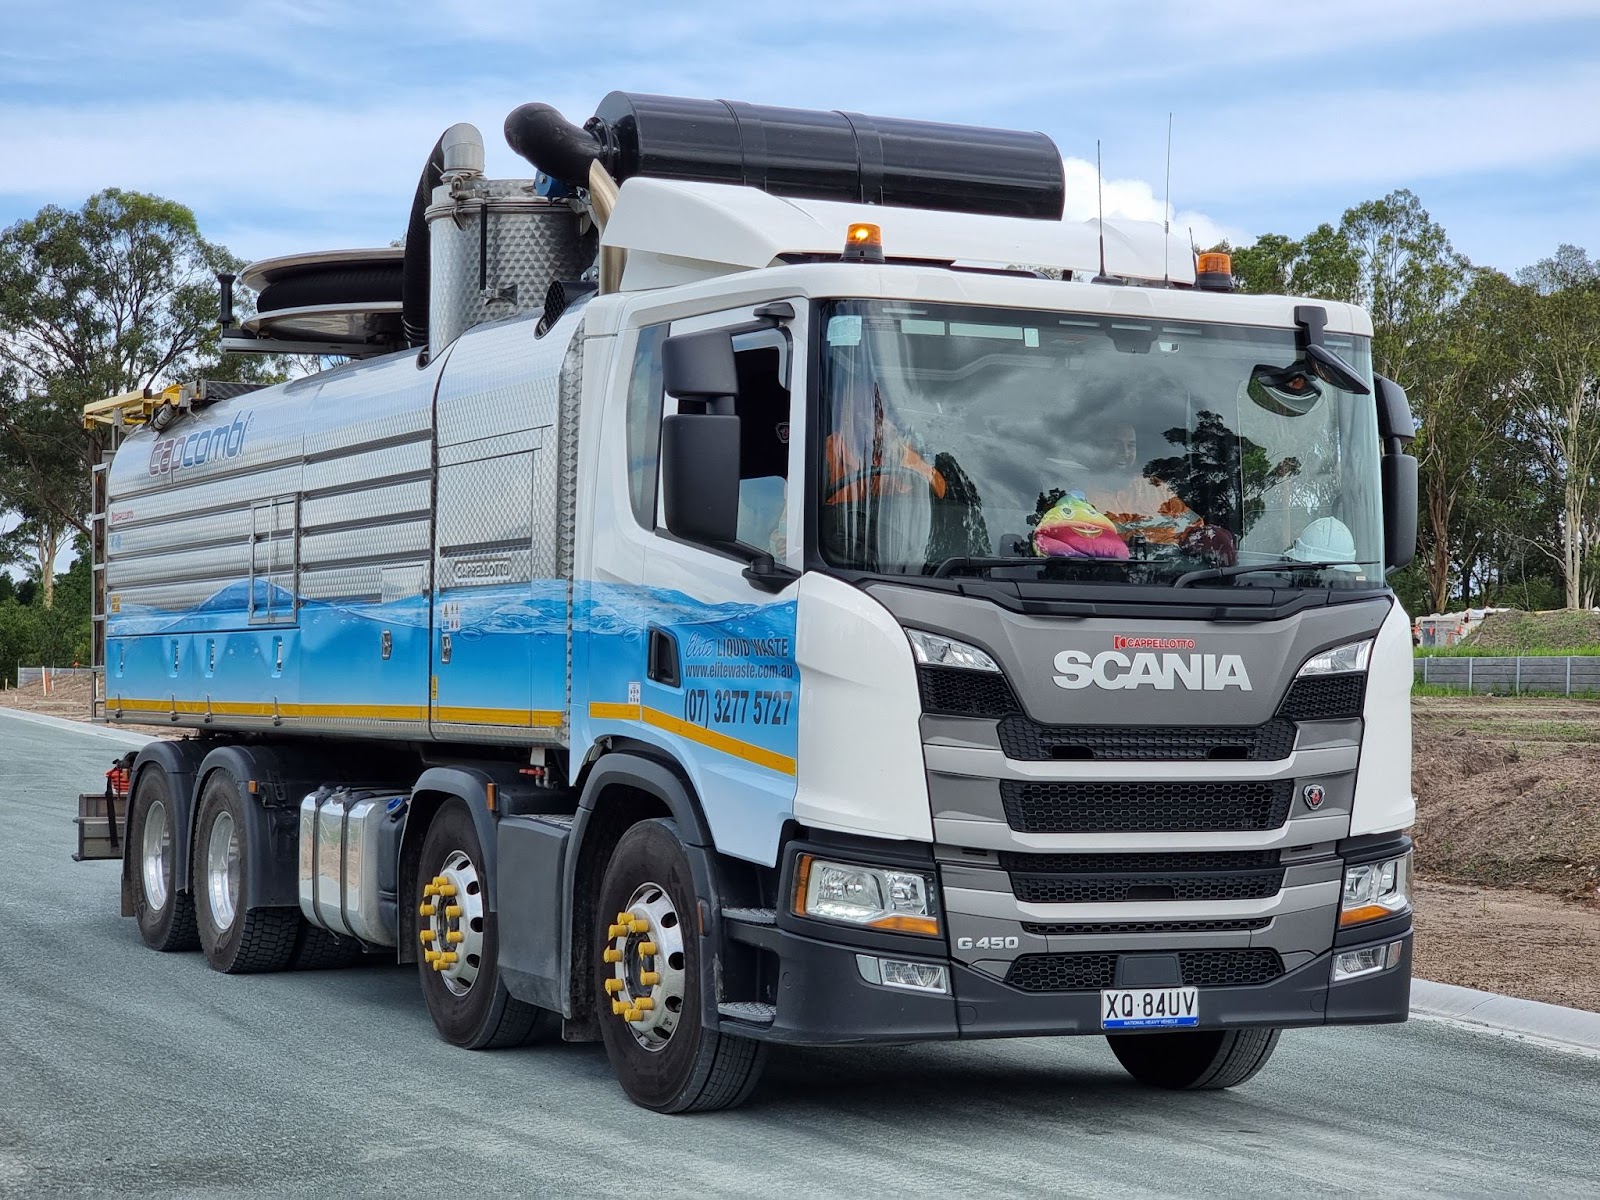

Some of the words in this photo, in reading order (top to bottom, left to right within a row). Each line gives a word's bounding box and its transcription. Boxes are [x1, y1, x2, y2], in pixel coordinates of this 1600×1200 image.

[685, 631, 715, 658] Elite
[716, 638, 750, 657] LIQUID
[751, 638, 789, 657] WASTE
[1127, 638, 1195, 648] CAPPELLOTTO
[685, 661, 793, 679] www.elitewaste.com.au
[1052, 650, 1253, 691] SCANIA
[685, 689, 709, 729] (07)
[713, 689, 749, 724] 3277
[753, 691, 793, 725] 5727
[957, 938, 974, 950] G
[976, 936, 1020, 950] 450
